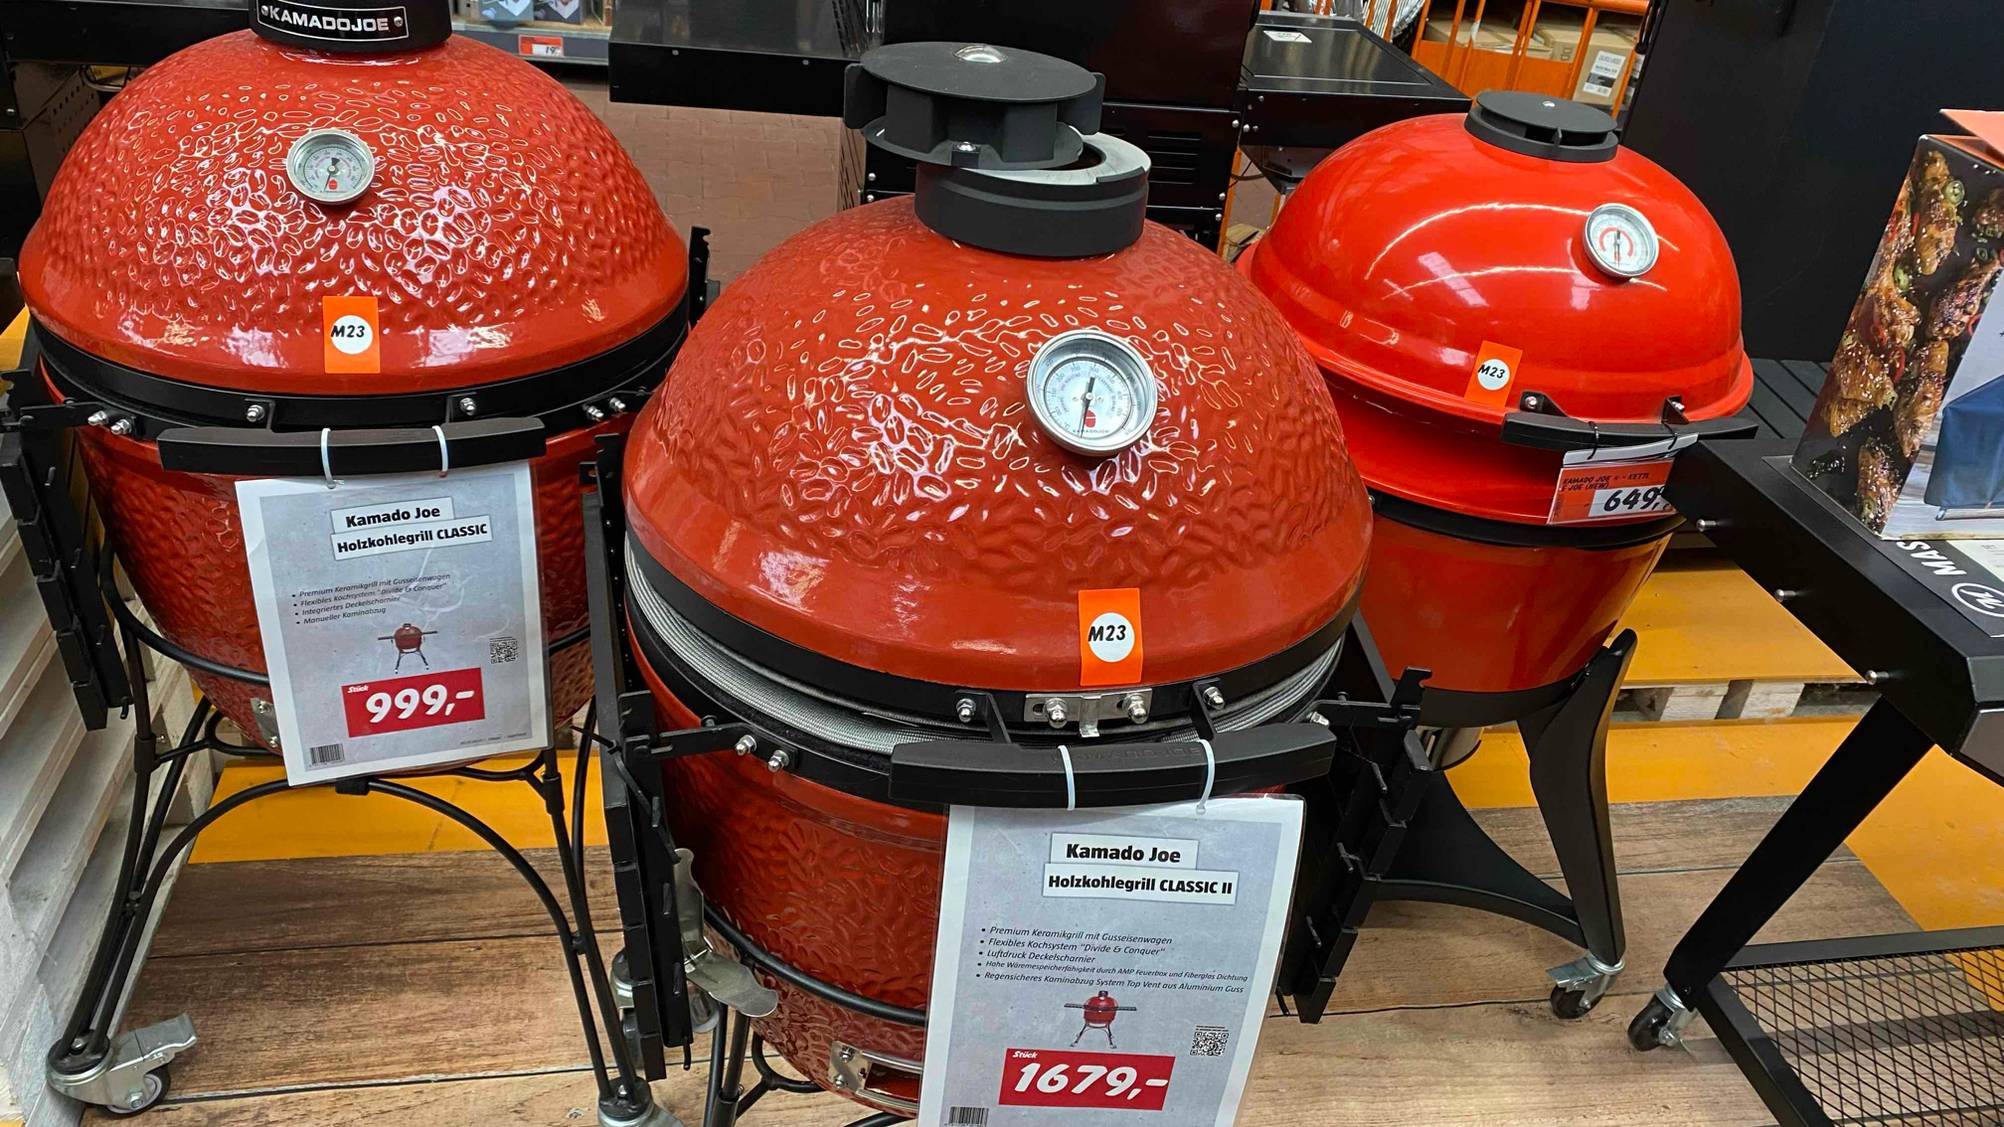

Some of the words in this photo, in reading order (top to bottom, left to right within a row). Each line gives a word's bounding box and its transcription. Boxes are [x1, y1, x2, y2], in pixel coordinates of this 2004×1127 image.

[270, 6, 389, 32] KAMADOJOE
[330, 324, 365, 338] M23
[1477, 364, 1506, 379] M23
[345, 508, 411, 528] Kamado
[414, 507, 441, 520] Joe
[337, 530, 433, 553] Holzkohlegrill
[436, 523, 488, 540] CLASSIC
[299, 588, 333, 597] Premium
[334, 581, 378, 593] Keramikgrill
[302, 604, 343, 616] Integriertes
[304, 614, 341, 624] Manueller
[342, 607, 386, 619] Kaminabzug
[1087, 624, 1127, 642] M23
[347, 684, 369, 694] Stück
[366, 684, 475, 723] 999,-
[1066, 843, 1145, 861] Kamado
[1149, 847, 1181, 863] Joe
[1049, 875, 1155, 892] Holzkohlegrill
[1159, 879, 1218, 894] CLASSIC
[1221, 882, 1232, 894] II
[988, 937, 1026, 948] Flexibles
[1027, 940, 1078, 951] Kochsystem
[1113, 945, 1121, 953] &
[989, 926, 1030, 936] Premium
[1031, 928, 1084, 940] Keramikgrill
[1085, 932, 1100, 941] mit
[1101, 933, 1172, 946] Gusseisenwagen
[987, 949, 1027, 960] Luftdruck
[1028, 952, 1096, 963] Deckelscharnier
[985, 960, 1005, 968] Hohe
[1135, 969, 1168, 977] Feuerbox
[1184, 971, 1215, 980] Fiberglas
[1216, 973, 1248, 982] Dichtung
[984, 971, 1042, 982] Regensicheres
[1043, 975, 1095, 986] Kaminabzug
[1095, 978, 1125, 987] System
[1127, 980, 1141, 988] Top
[1143, 980, 1160, 989] Vent
[1178, 983, 1223, 992] Aluminium
[1224, 985, 1245, 993] Guss
[1012, 1050, 1038, 1059] Stück
[1014, 1062, 1168, 1101] 1679,-
